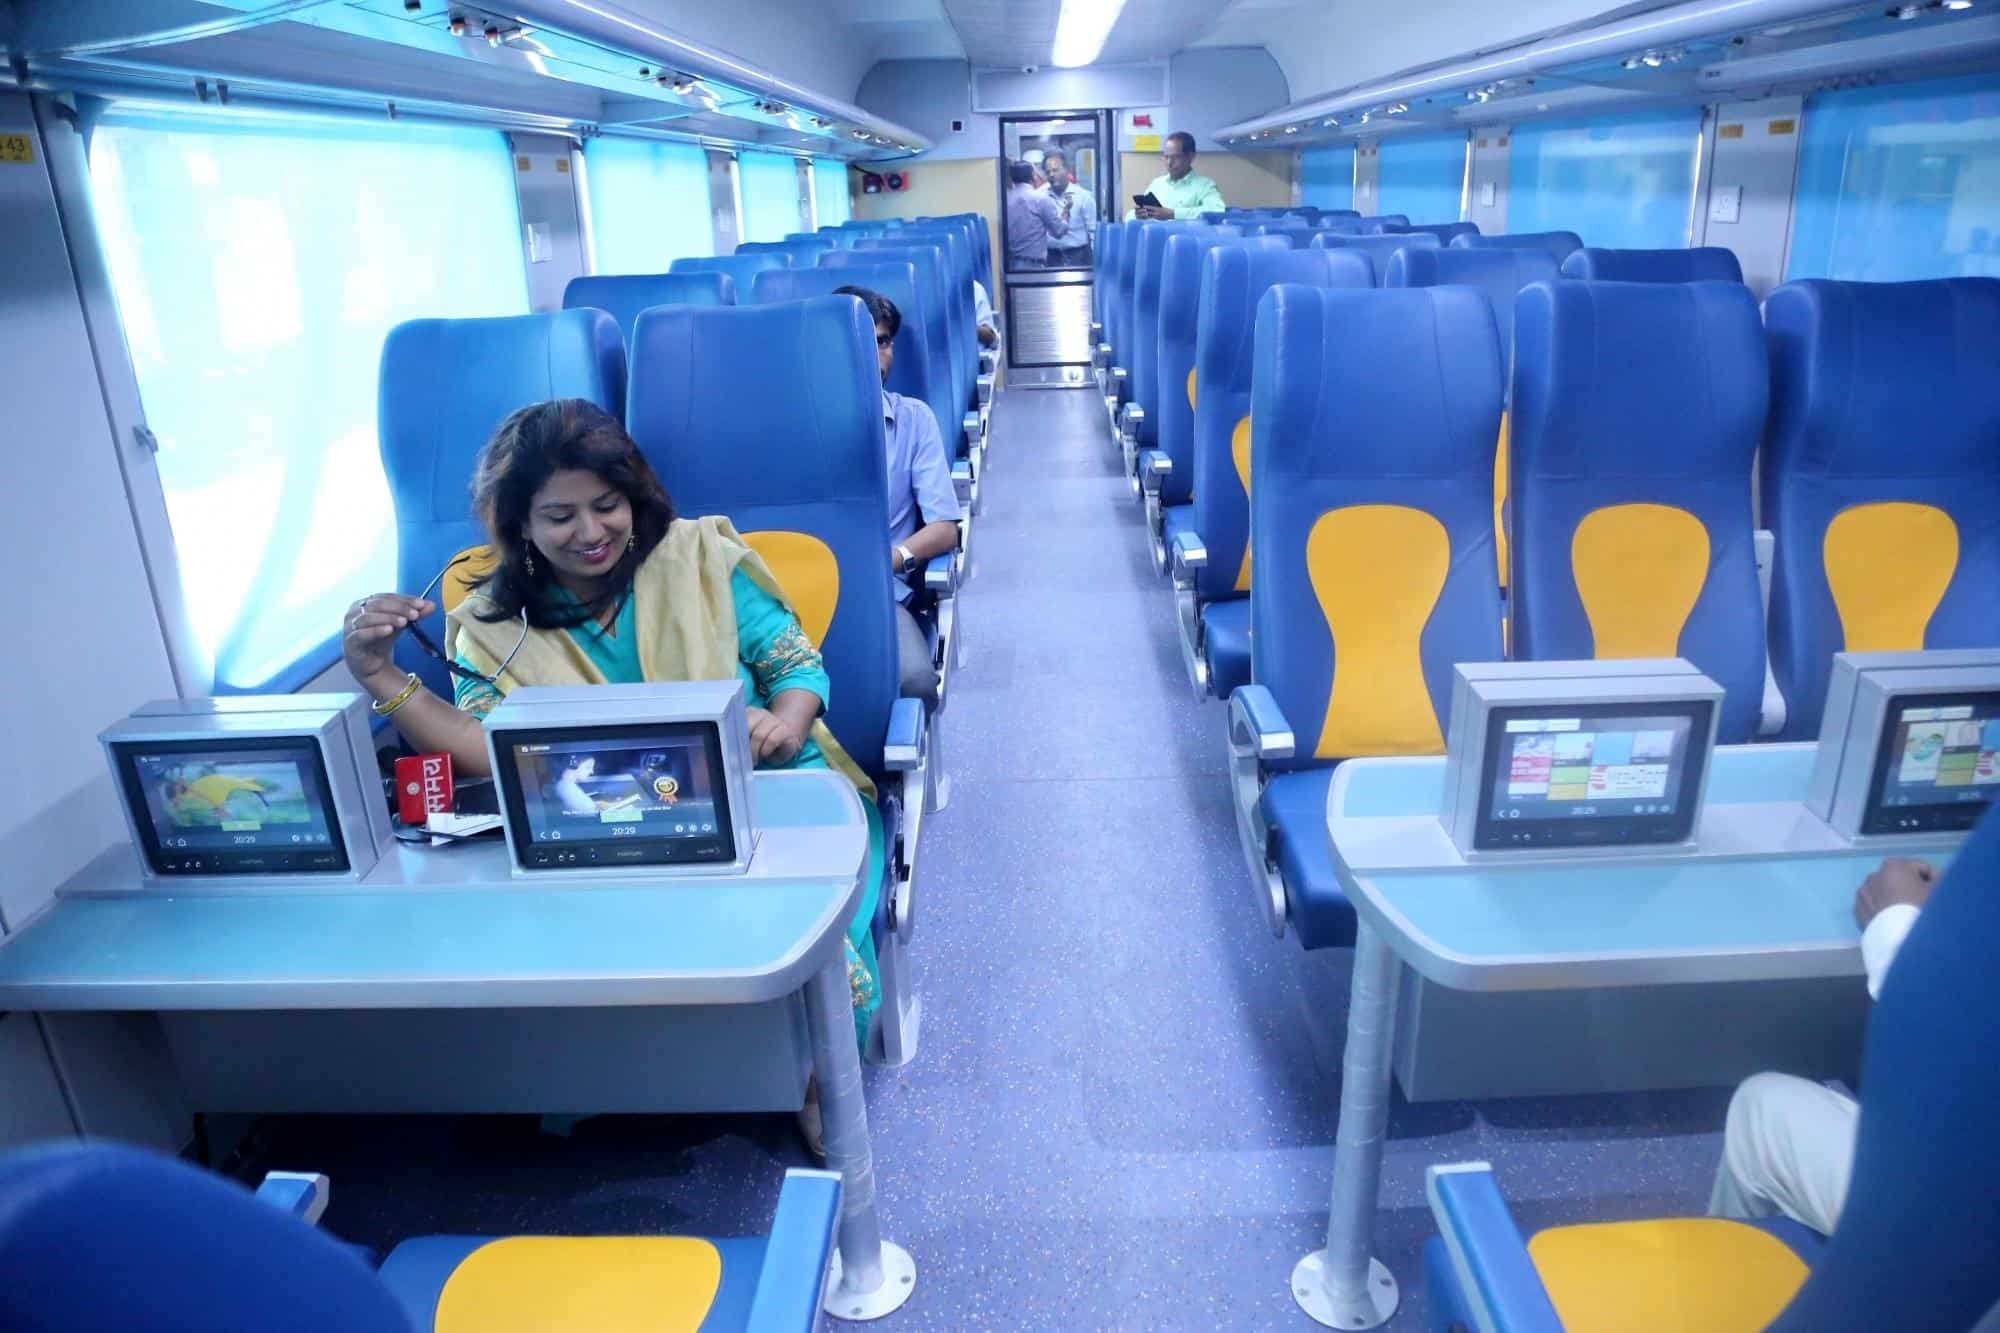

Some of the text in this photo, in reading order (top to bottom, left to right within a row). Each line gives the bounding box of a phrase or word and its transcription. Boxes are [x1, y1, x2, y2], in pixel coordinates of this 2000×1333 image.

[7, 137, 25, 152] 43
[422, 757, 446, 815] समय
[611, 826, 636, 836] 20:29
[233, 834, 256, 845] 20:29
